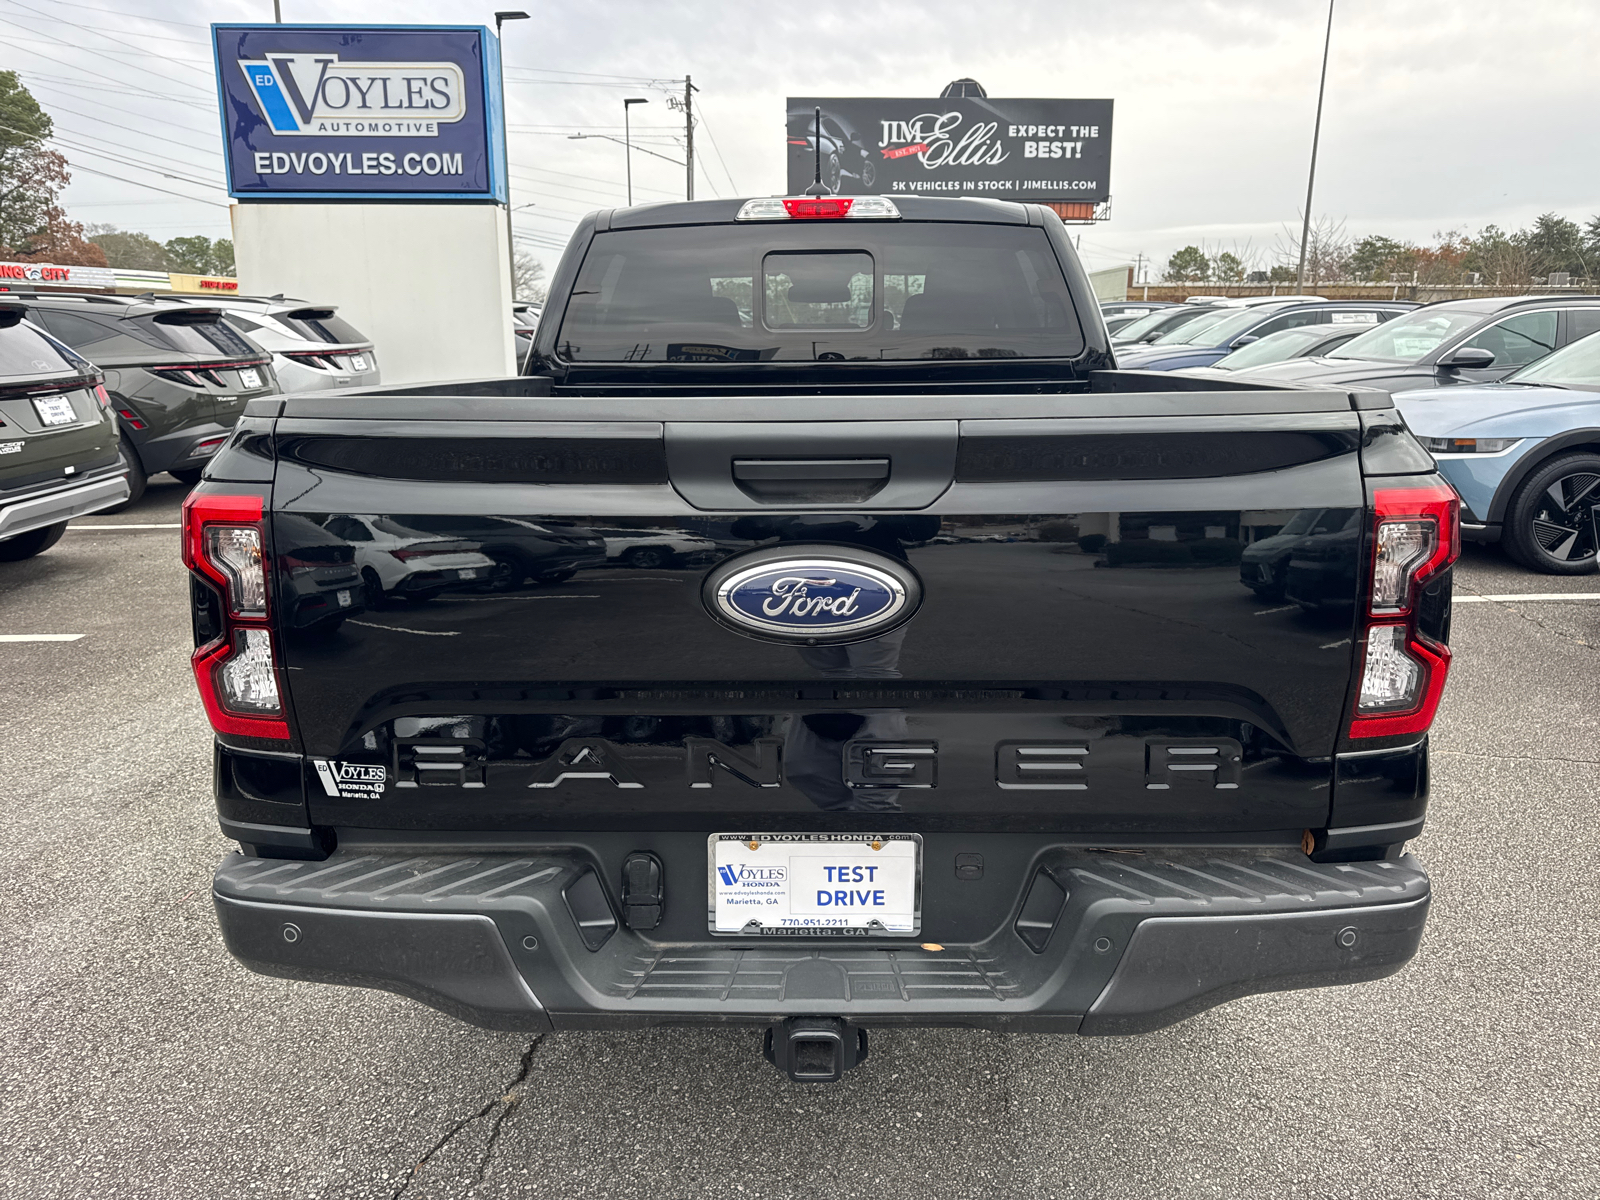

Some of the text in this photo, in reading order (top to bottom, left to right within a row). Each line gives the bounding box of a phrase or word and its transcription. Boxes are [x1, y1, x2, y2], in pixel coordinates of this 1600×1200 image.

[255, 75, 274, 86] ED
[271, 58, 451, 124] VOYLES
[318, 122, 435, 133] AUTOMOTIVE
[878, 120, 924, 147] JIM
[1008, 125, 1099, 138] EXPECT THE
[909, 111, 1011, 170] Ellis
[1023, 141, 1083, 159] BEST!
[254, 152, 464, 175] EDVOYLES.COM
[892, 180, 1097, 191] 5K VEHICLES IN STOCK JIMELLIS.COM
[41, 267, 70, 281] CITY
[763, 576, 861, 617] Ford
[318, 764, 328, 772] ED
[328, 761, 384, 782] VOYLES
[392, 737, 1244, 790] RANGER
[338, 783, 375, 791] HONDA
[726, 864, 785, 884] VOYLES
[823, 866, 878, 883] TEST
[726, 898, 763, 906] Marietta,
[816, 890, 886, 906] DRIVE
[763, 927, 866, 936] Marietta, GA
